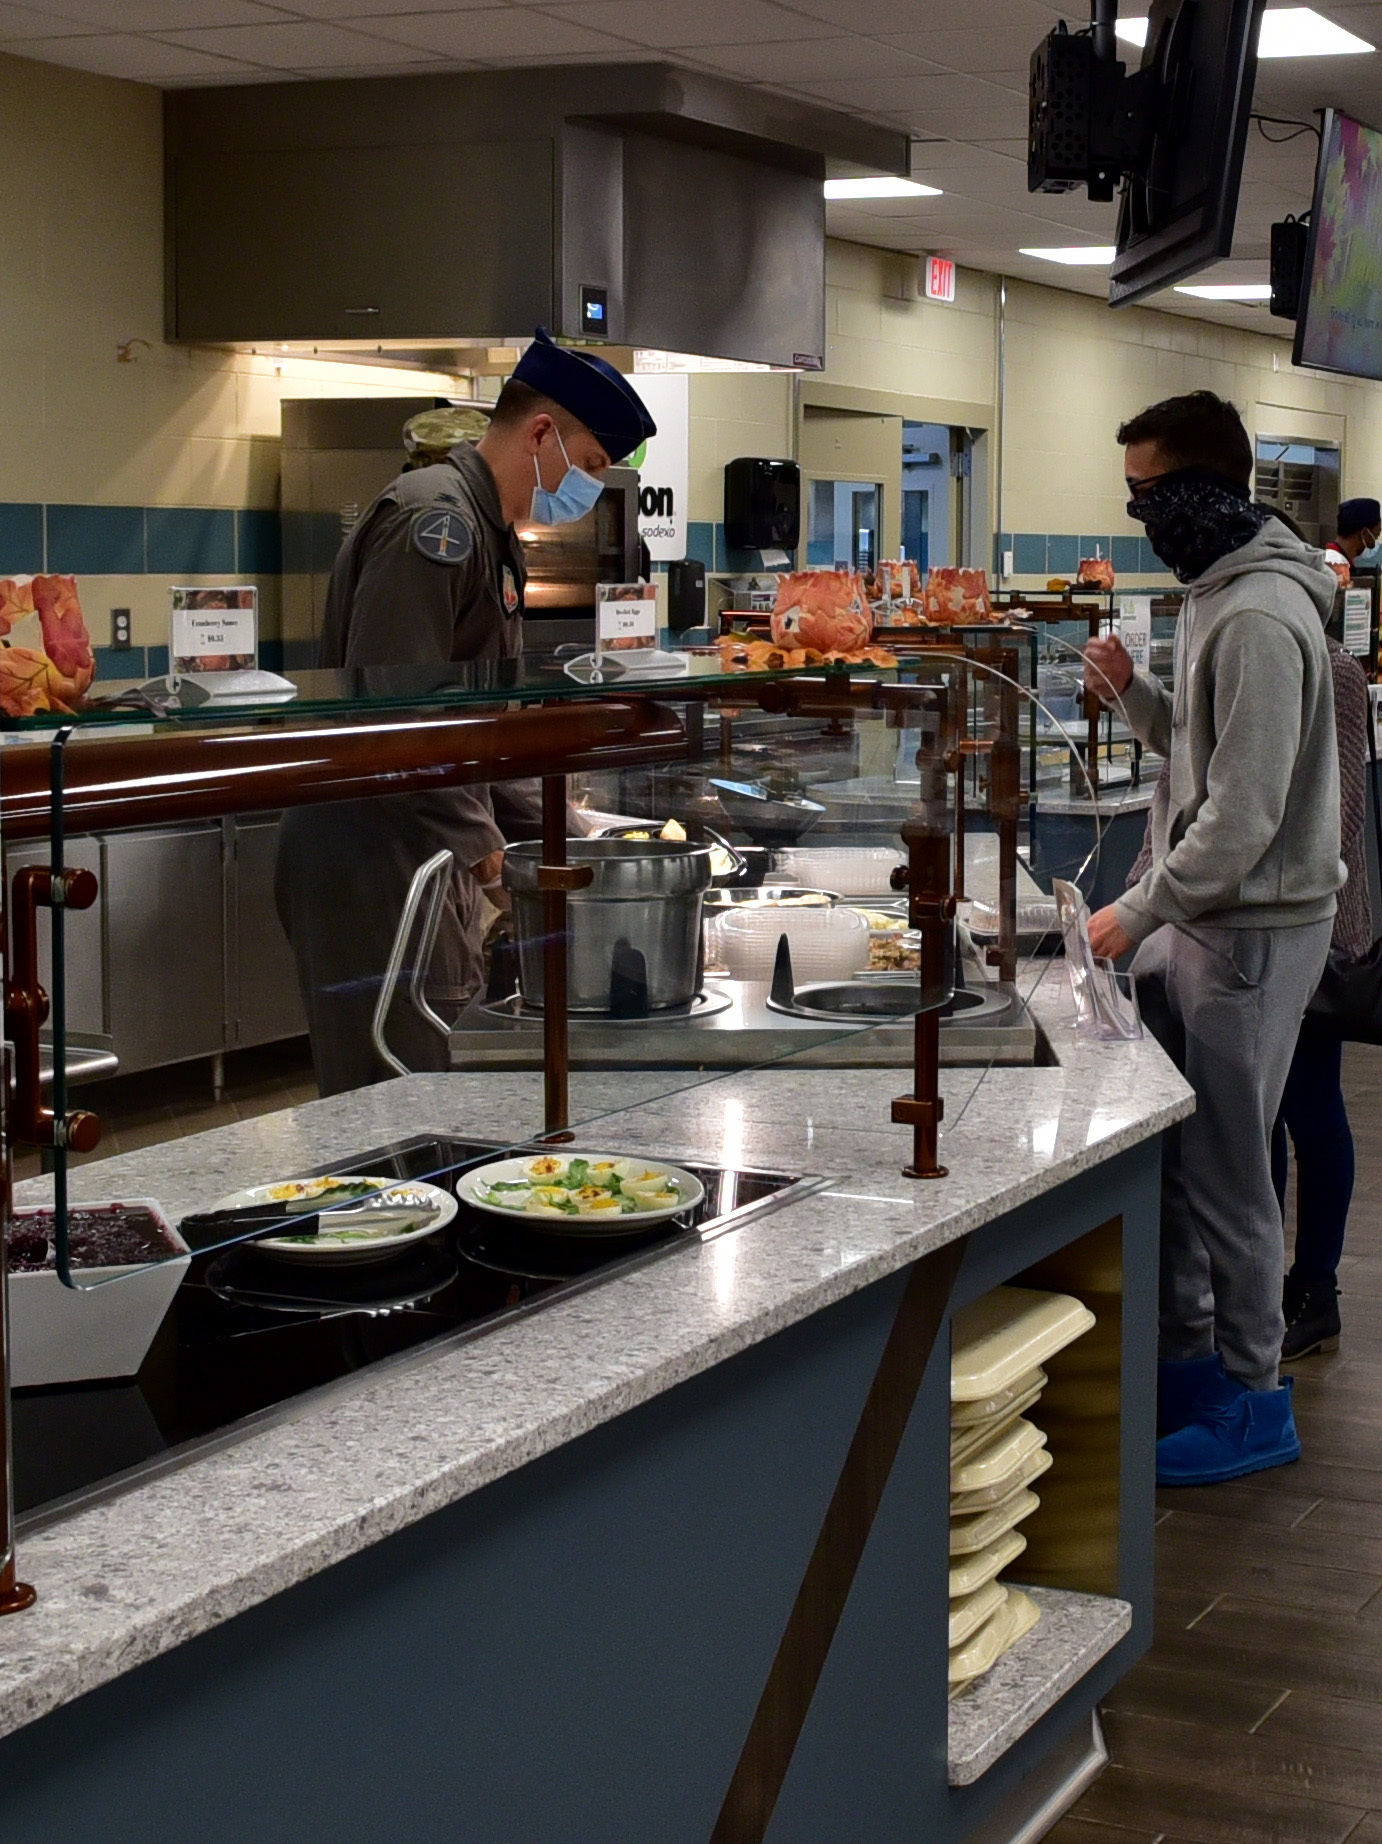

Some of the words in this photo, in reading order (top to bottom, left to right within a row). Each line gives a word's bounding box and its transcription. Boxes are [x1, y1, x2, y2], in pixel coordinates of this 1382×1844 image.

[931, 258, 953, 299] EXIT
[641, 525, 676, 538] sodexo
[1125, 632, 1147, 648] ORDER
